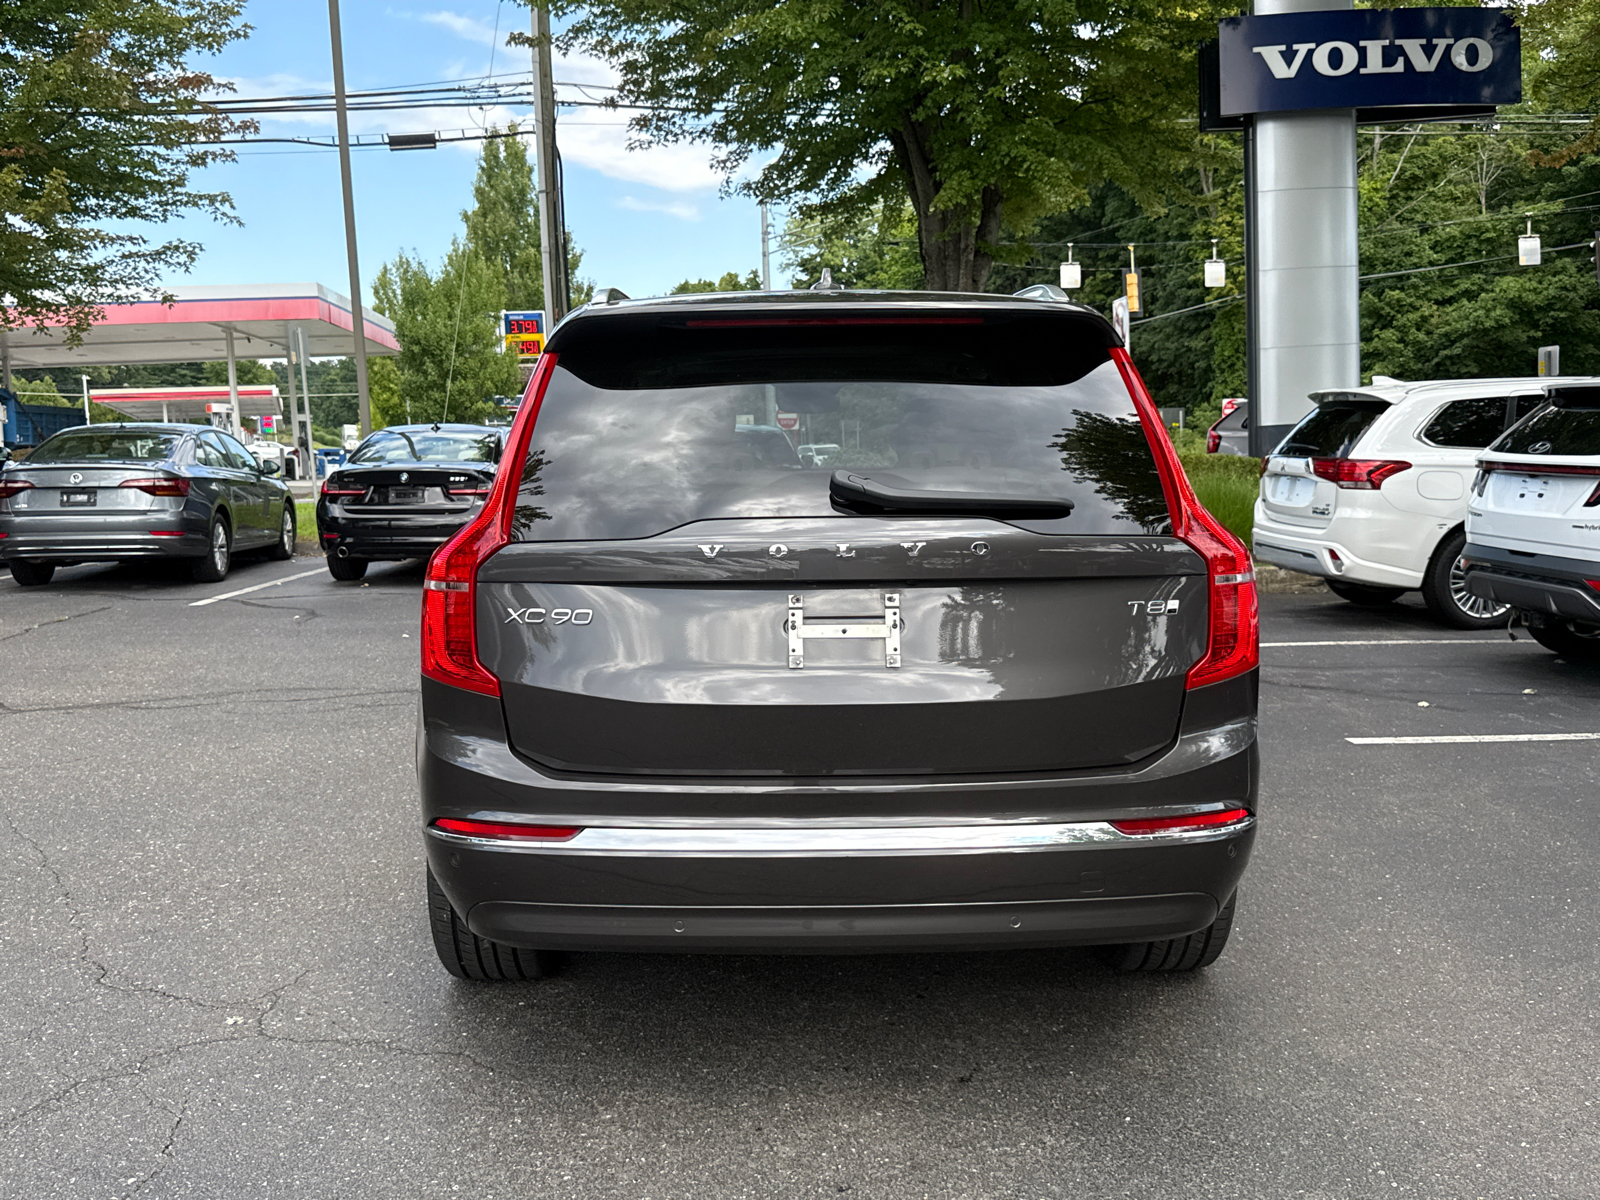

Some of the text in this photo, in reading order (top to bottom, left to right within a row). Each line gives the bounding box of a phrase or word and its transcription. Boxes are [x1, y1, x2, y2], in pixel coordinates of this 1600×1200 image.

[1252, 37, 1494, 80] VOLVO
[697, 541, 990, 559] VOLVO
[1127, 600, 1166, 616] T8
